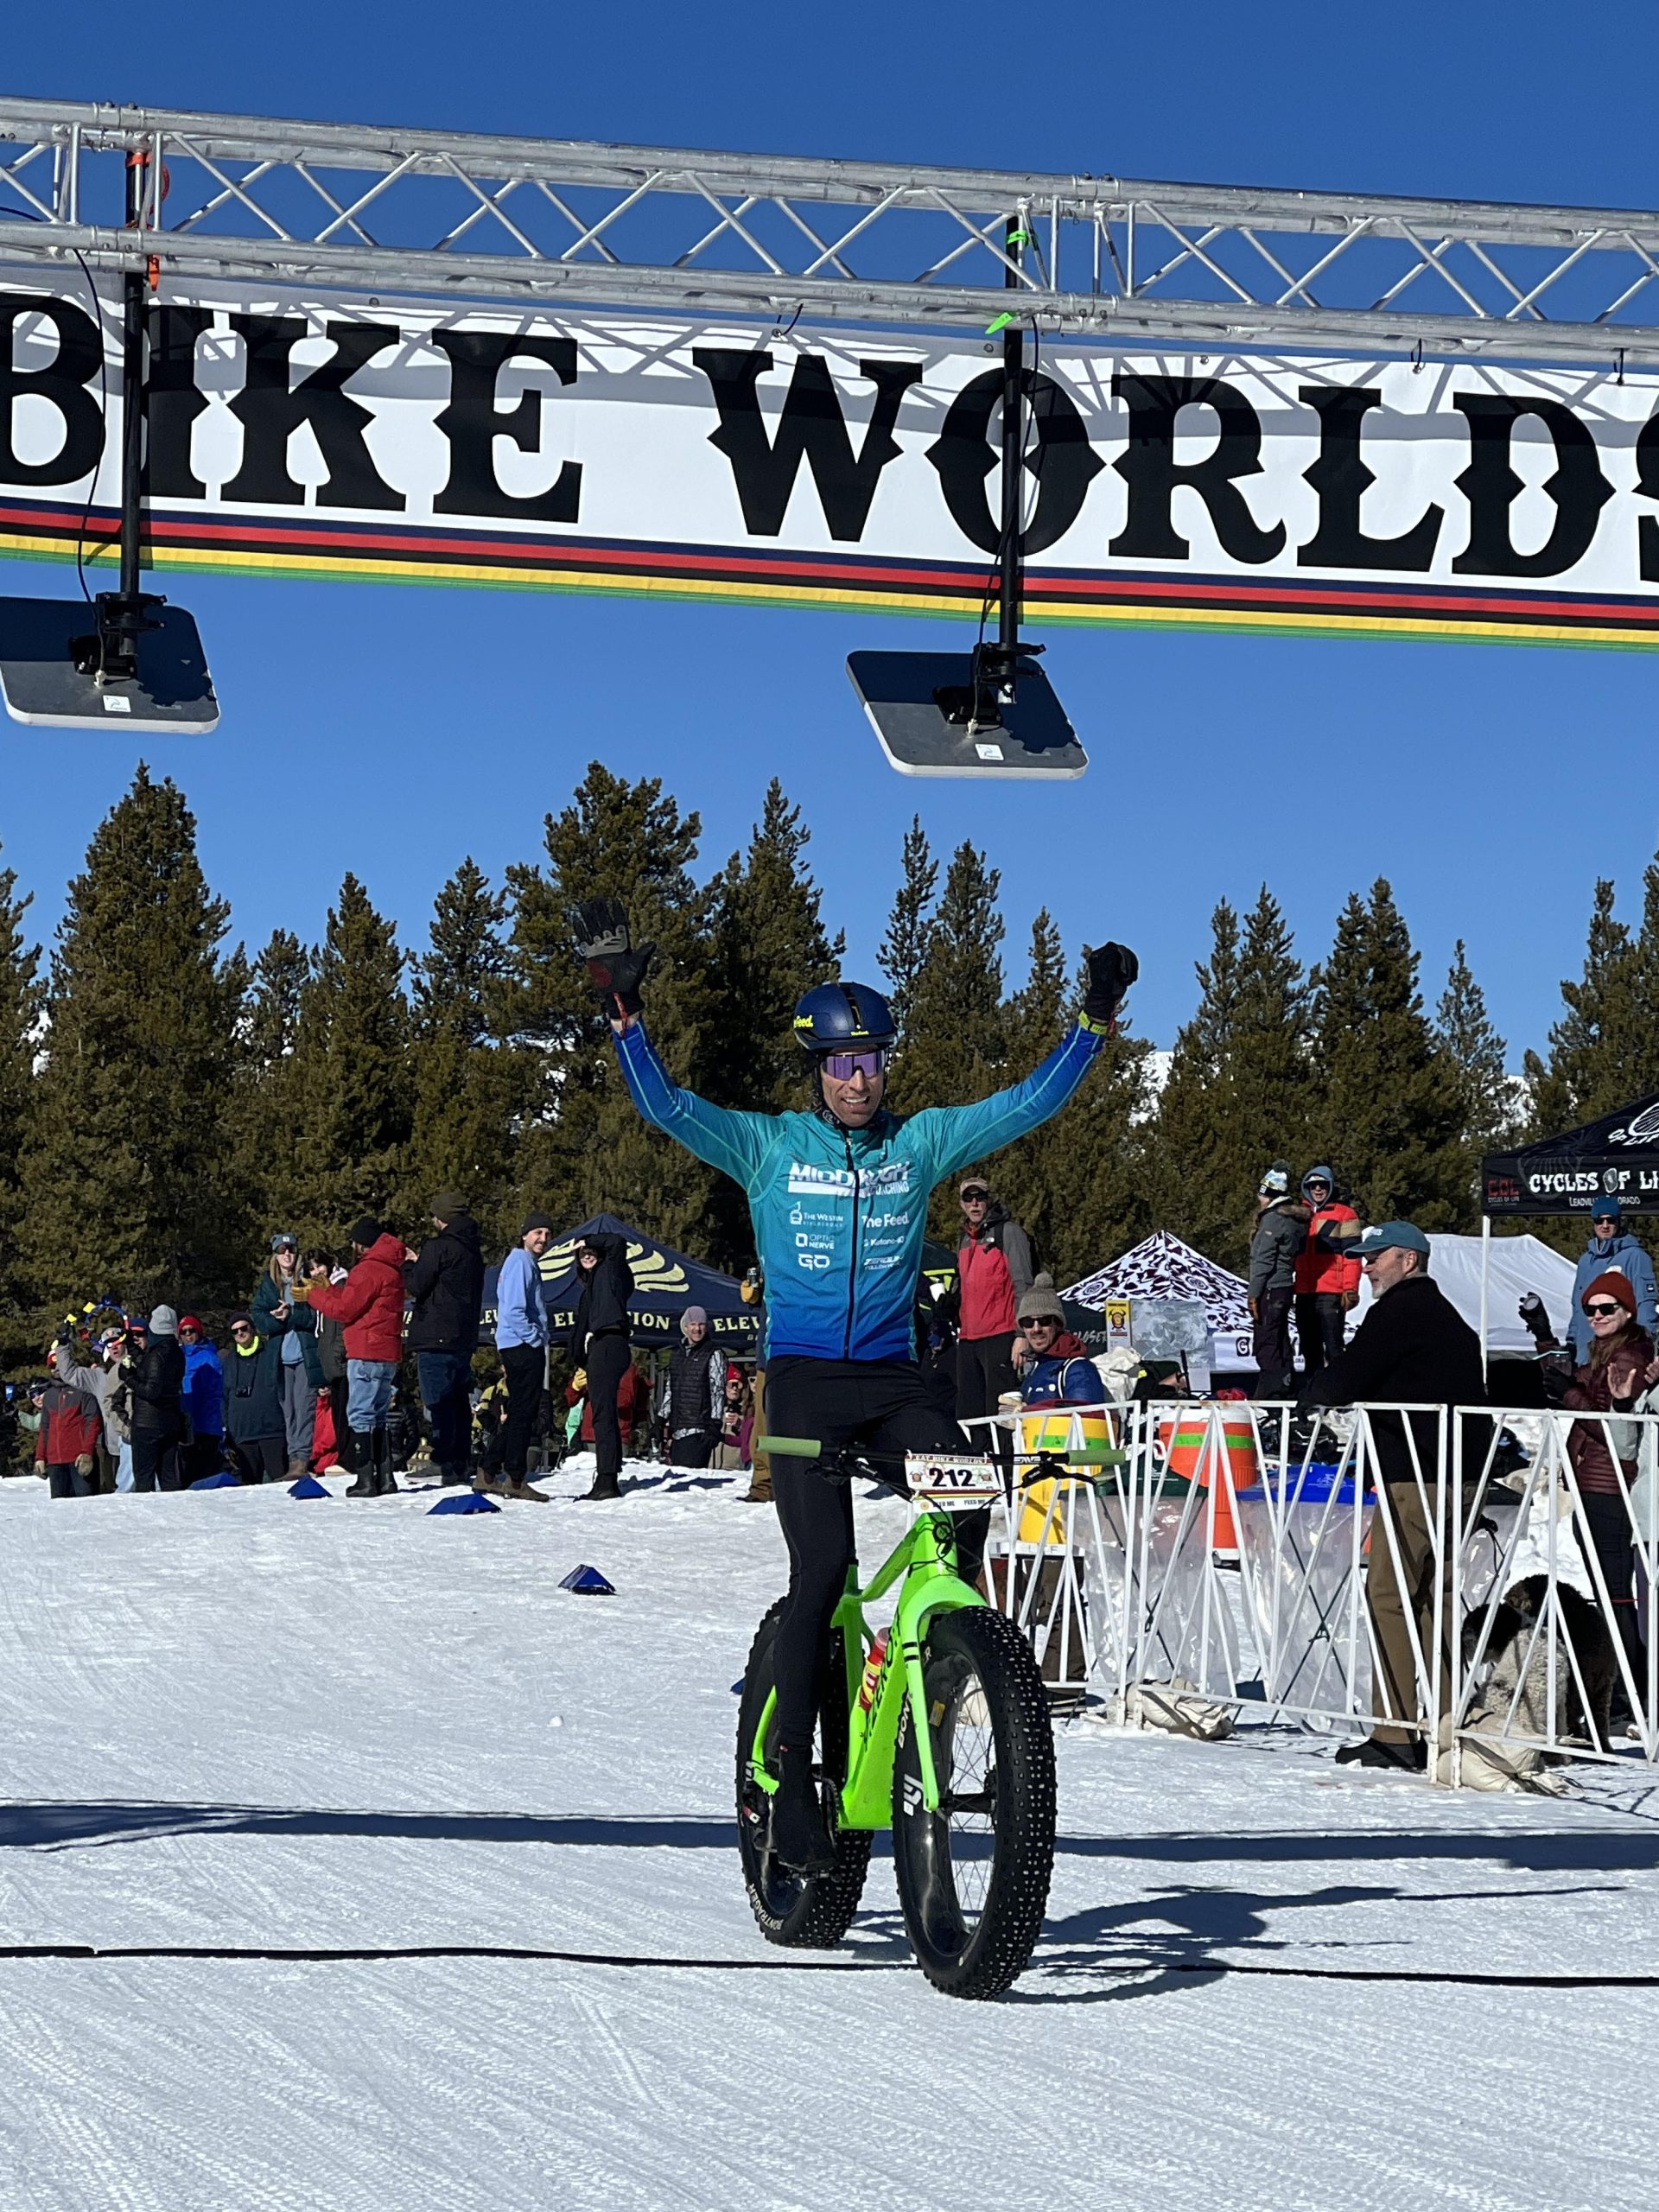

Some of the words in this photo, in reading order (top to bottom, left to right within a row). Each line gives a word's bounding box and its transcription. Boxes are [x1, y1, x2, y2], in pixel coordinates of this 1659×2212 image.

[0, 292, 582, 524] BIKE
[693, 346, 1659, 584] WORLD
[1487, 1179, 1520, 1197] COL
[1529, 1172, 1599, 1193] CYCLES
[1603, 1167, 1630, 1193] OF
[1569, 1197, 1599, 1207] LEADVIL
[929, 1467, 976, 1487] 212
